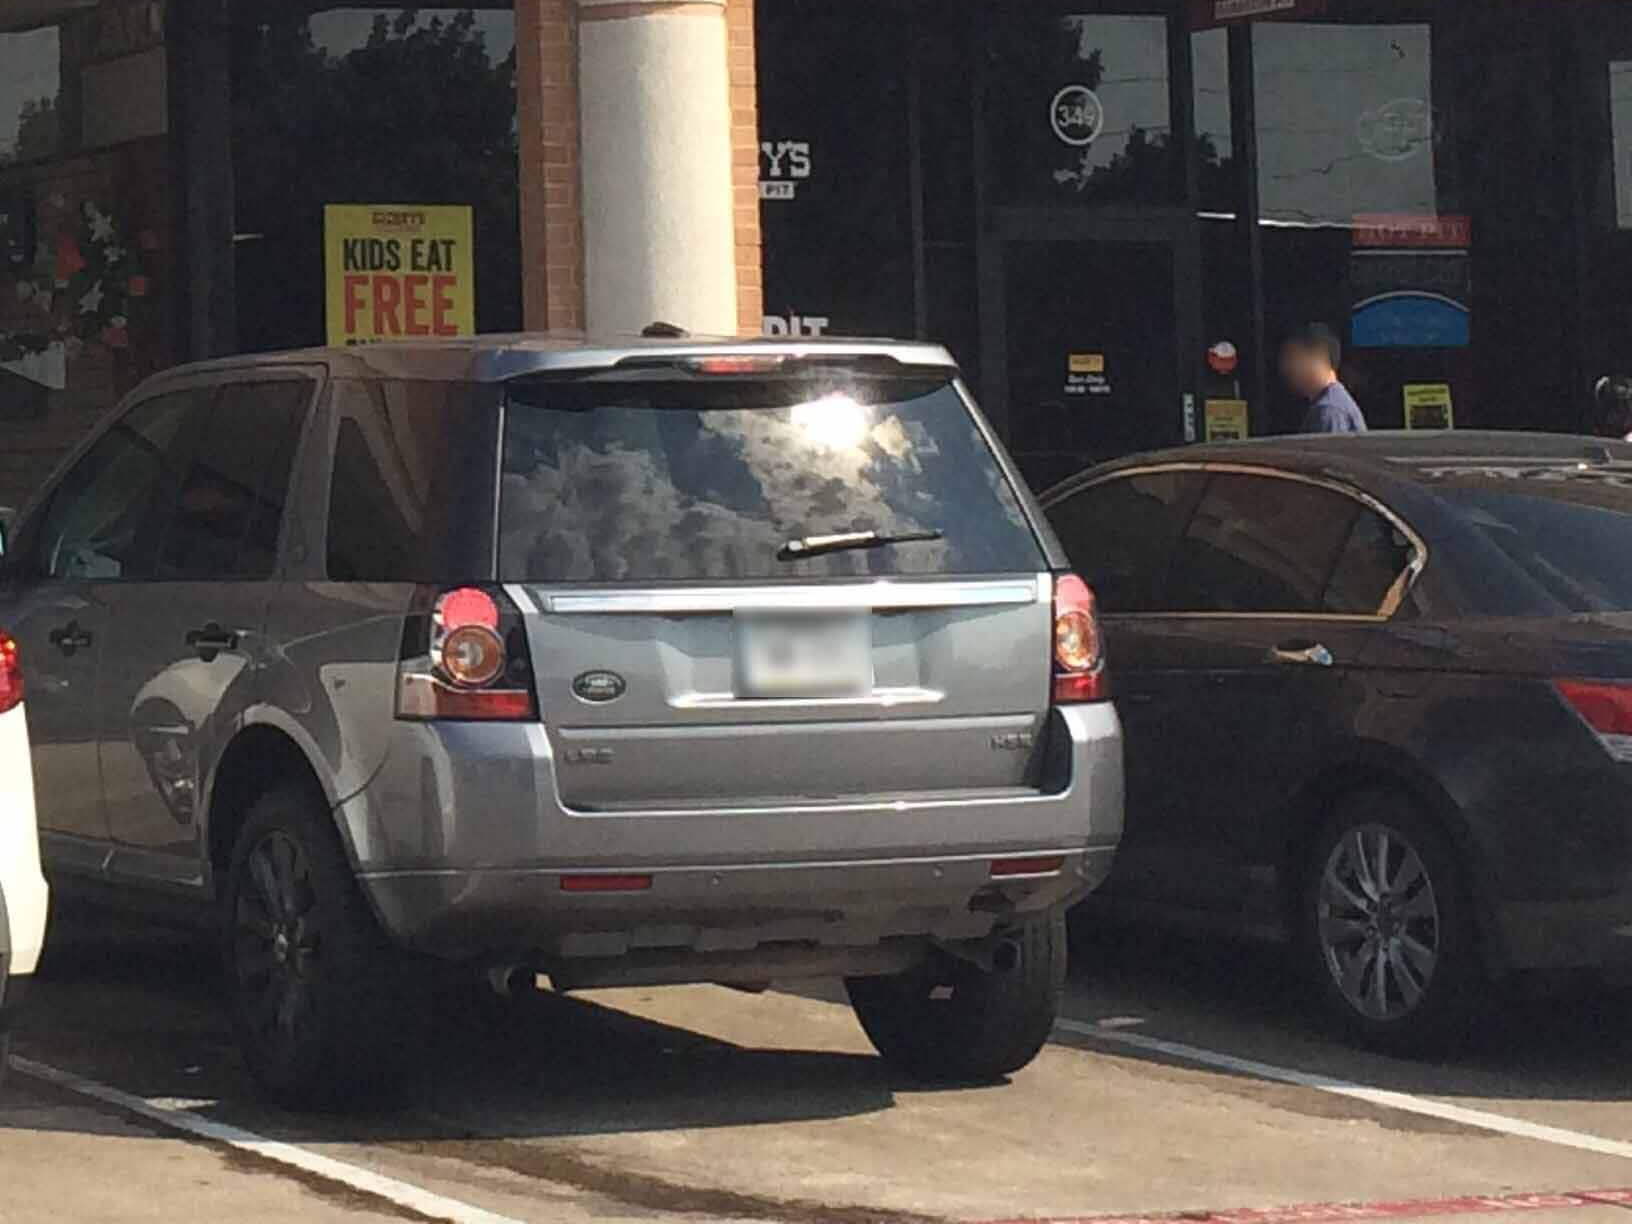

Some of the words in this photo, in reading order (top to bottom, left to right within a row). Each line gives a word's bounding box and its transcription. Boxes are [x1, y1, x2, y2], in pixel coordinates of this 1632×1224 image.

[343, 237, 401, 273] KIDS
[410, 239, 457, 273] EAT
[343, 275, 459, 337] FREE
